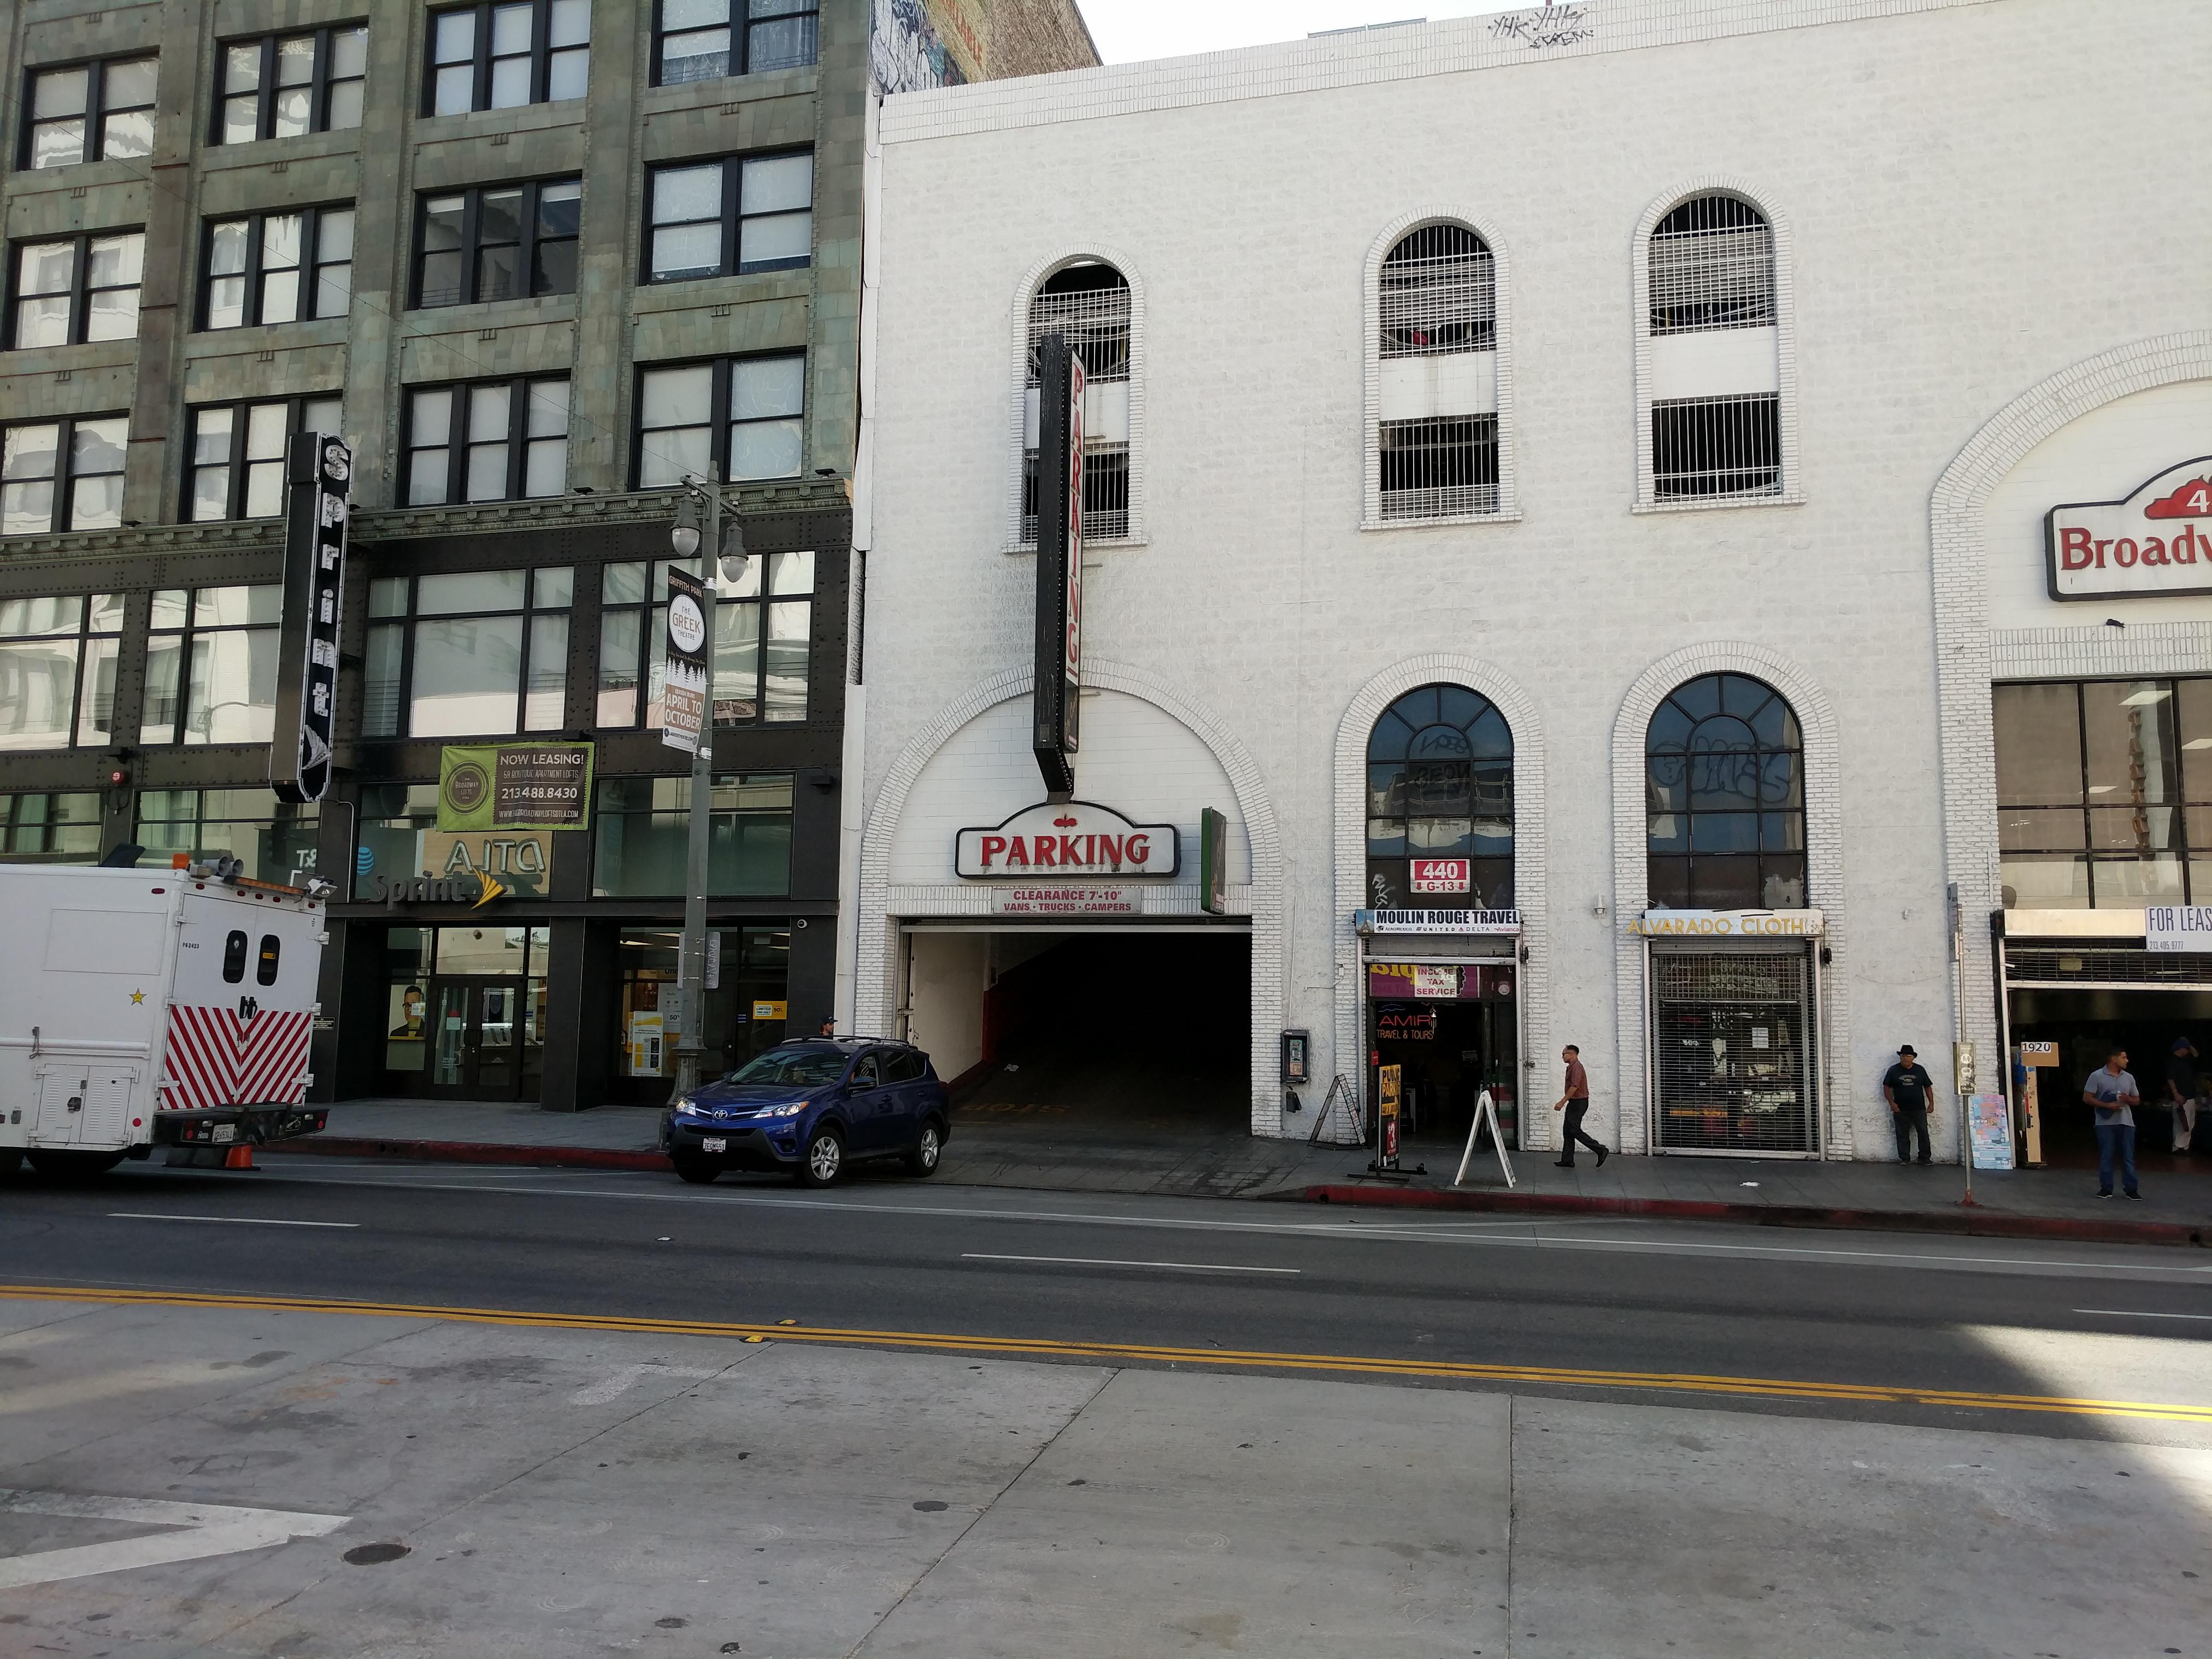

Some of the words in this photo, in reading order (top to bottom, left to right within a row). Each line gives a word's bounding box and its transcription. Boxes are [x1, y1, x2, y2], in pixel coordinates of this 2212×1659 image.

[2186, 490, 2212, 513] 4
[1067, 363, 1083, 664] PARKING
[312, 444, 349, 717] Sprint
[669, 575, 690, 592] GRIFFITH
[691, 585, 703, 598] PARK
[682, 606, 691, 615] THE
[673, 613, 701, 634] GREEK
[678, 630, 696, 640] THEATRE
[666, 693, 690, 711] APRIL
[692, 700, 702, 715] TO
[665, 709, 701, 730] OCTOBER
[500, 754, 530, 766] NOW
[532, 754, 584, 766] LEASING!
[503, 770, 511, 779] 58
[511, 769, 534, 779] BOUTIQUE
[535, 770, 562, 779] APARTMENT
[563, 770, 579, 778] LOFTS
[501, 787, 578, 799] 213.488.8430
[980, 834, 1150, 867] PARKING
[1422, 862, 1458, 879] 440
[369, 870, 468, 911] Sprint
[1427, 881, 1455, 892] G-13
[1013, 890, 1085, 901] CLEARANCE
[1004, 903, 1030, 911] VANS
[1039, 903, 1075, 911] TRUCKS
[1376, 911, 1423, 924] MOULIN
[1427, 911, 1469, 924] ROUGE
[1472, 911, 1519, 923] TRAVEL
[2149, 908, 2174, 931] FOR
[1627, 918, 1732, 934] ALVARADO
[1741, 917, 1804, 934] CLOTH
[2149, 941, 2184, 950] 213.405.9777
[1379, 1015, 1432, 1026] AMIR
[1376, 1029, 1401, 1039] TRAVEL
[1403, 1030, 1408, 1039] &
[1411, 1030, 1433, 1039] TOURS
[2022, 1043, 2050, 1052] 1920
